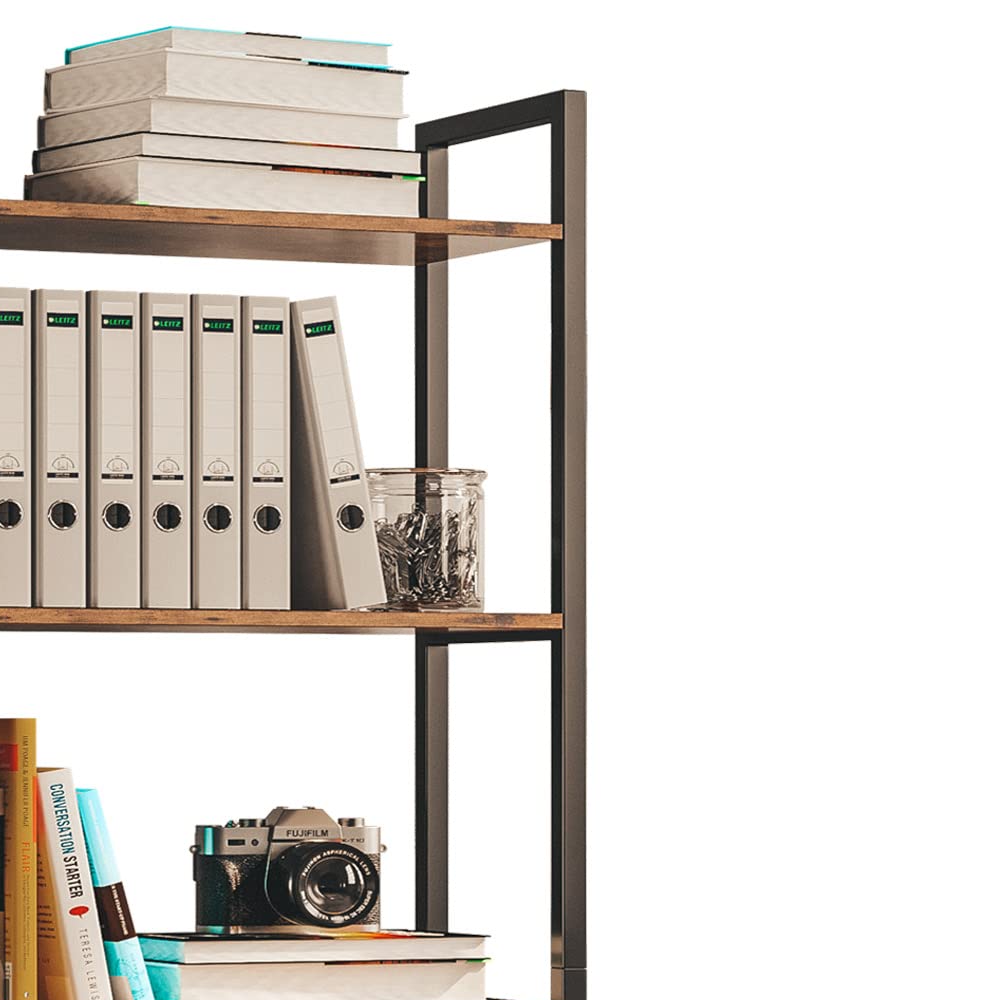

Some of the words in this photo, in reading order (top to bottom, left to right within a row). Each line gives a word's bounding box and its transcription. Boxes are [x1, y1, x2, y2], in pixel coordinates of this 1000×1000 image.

[50, 783, 77, 855] CONVERSATION
[286, 829, 329, 838] FUJIFILM
[21, 841, 31, 873] FLAIR
[63, 855, 84, 899] STARTER
[79, 928, 96, 966] TERESA
